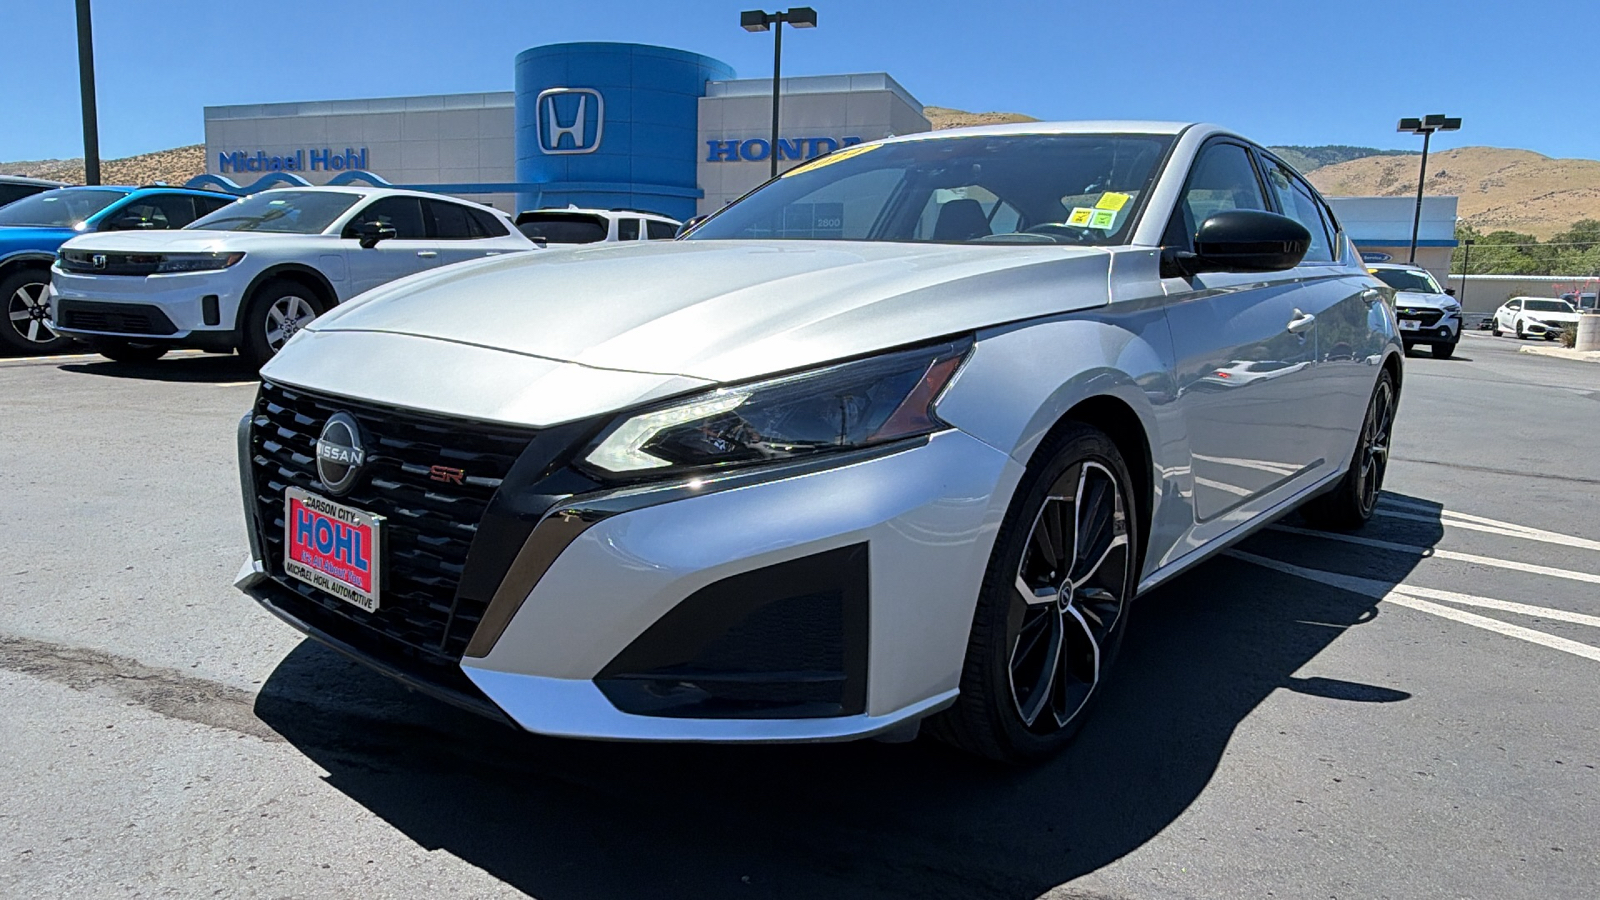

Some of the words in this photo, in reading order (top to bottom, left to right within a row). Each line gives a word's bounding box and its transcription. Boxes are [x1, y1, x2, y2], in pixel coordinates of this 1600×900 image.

[219, 150, 301, 173] Michael
[309, 147, 368, 172] Hohl
[817, 218, 841, 228] 2800
[317, 443, 363, 465] NISSAN
[430, 465, 465, 486] SR
[306, 496, 337, 518] CARSON
[296, 507, 369, 572] HOHL
[312, 555, 323, 569] All
[324, 559, 346, 580] About
[287, 562, 313, 581] MICHAEL
[313, 573, 330, 591] HOHL
[331, 582, 374, 610] AUTOMOTIVE
